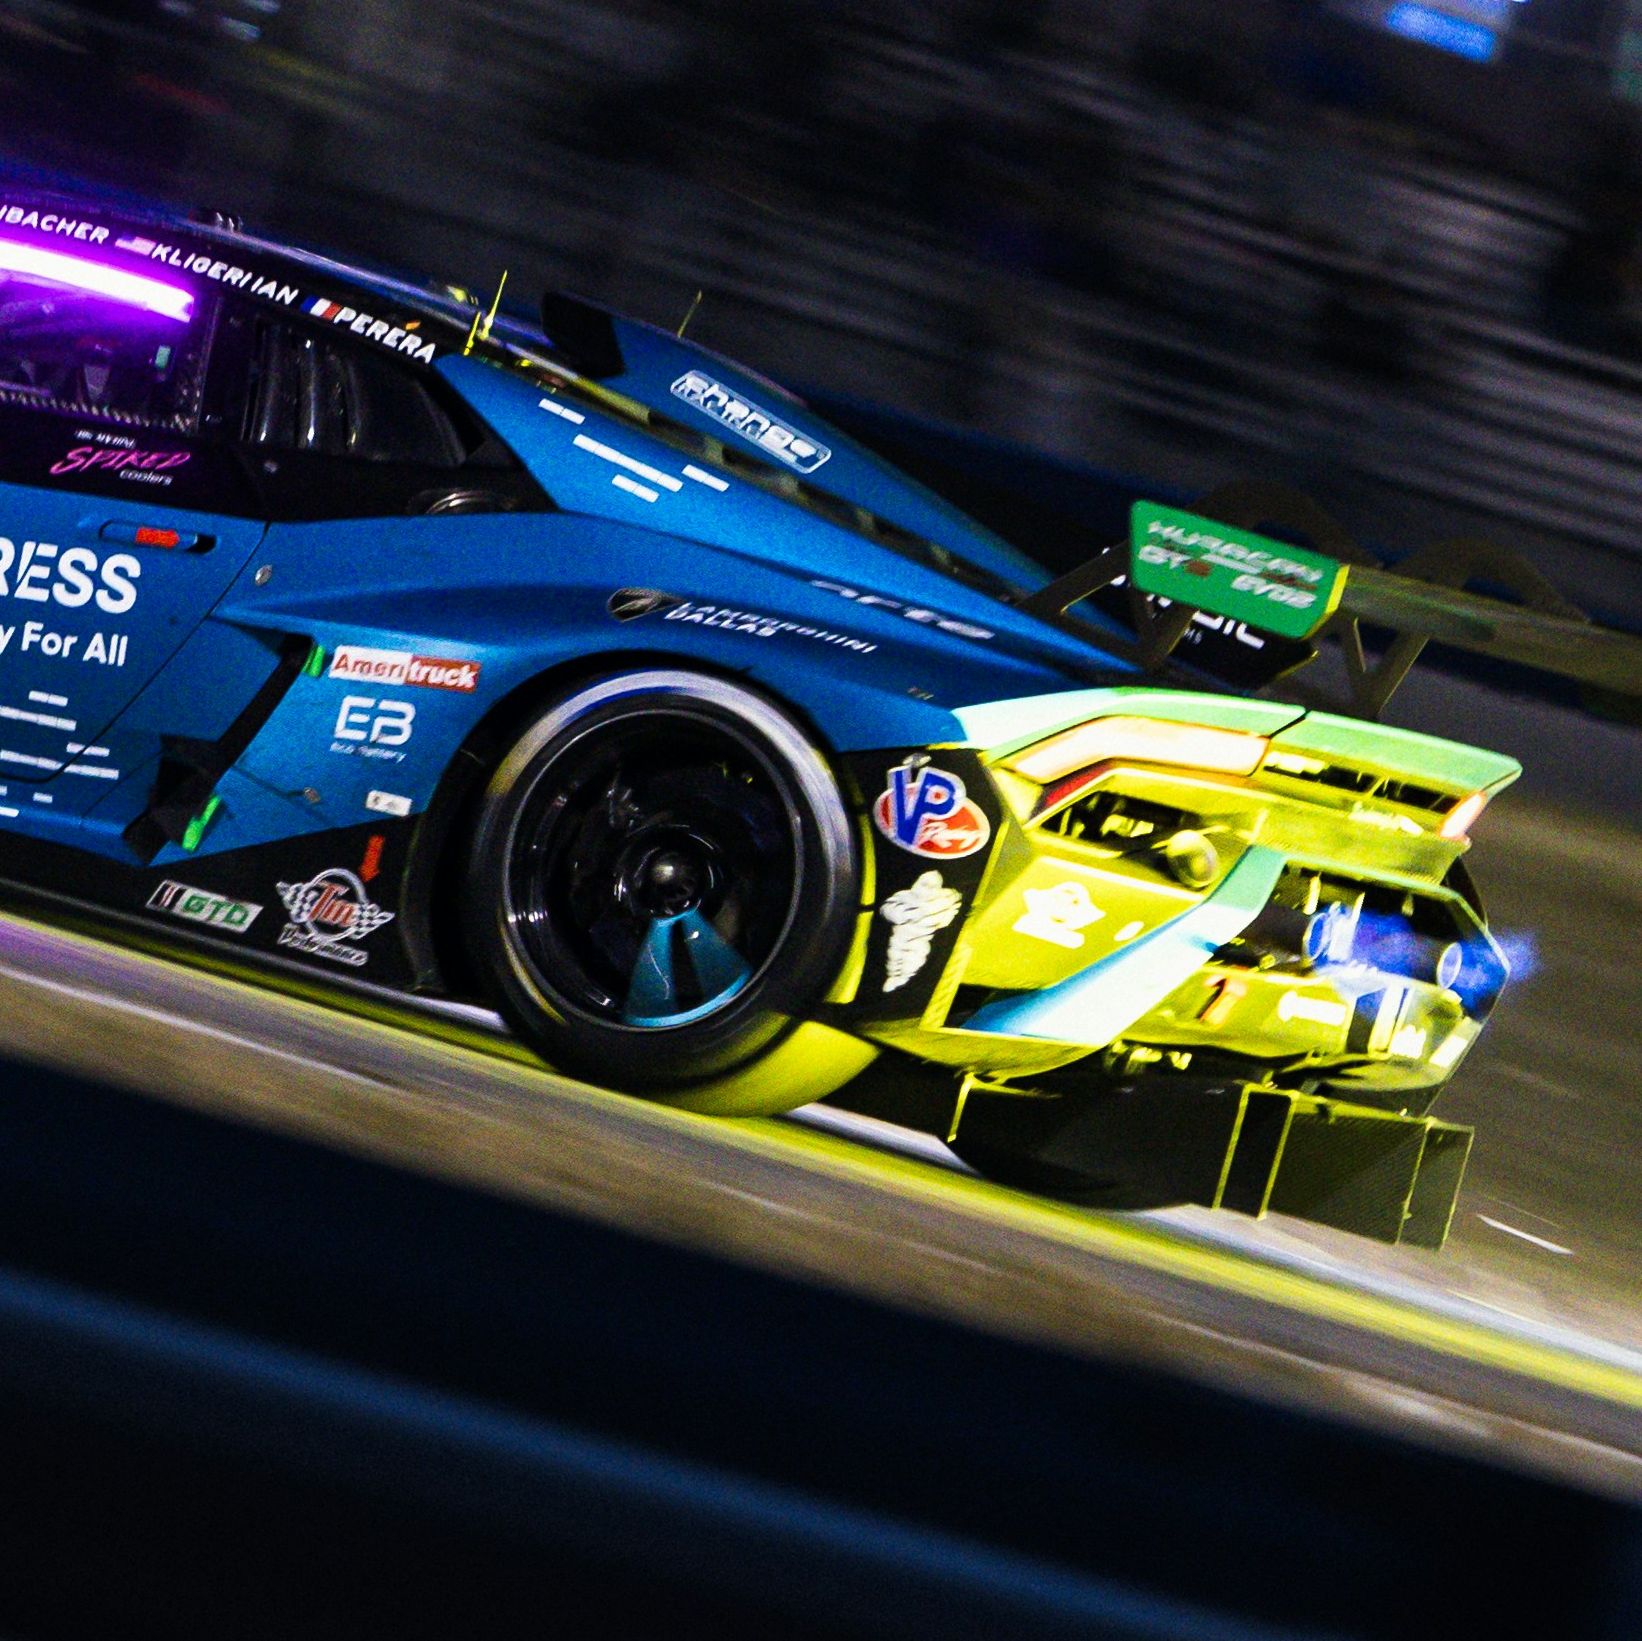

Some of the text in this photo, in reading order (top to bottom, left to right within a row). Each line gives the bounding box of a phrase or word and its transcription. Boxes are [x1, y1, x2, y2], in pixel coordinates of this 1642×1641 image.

[333, 306, 437, 365] PERERA
[21, 620, 78, 659] For
[82, 632, 129, 668] All
[182, 894, 250, 927] GTD
